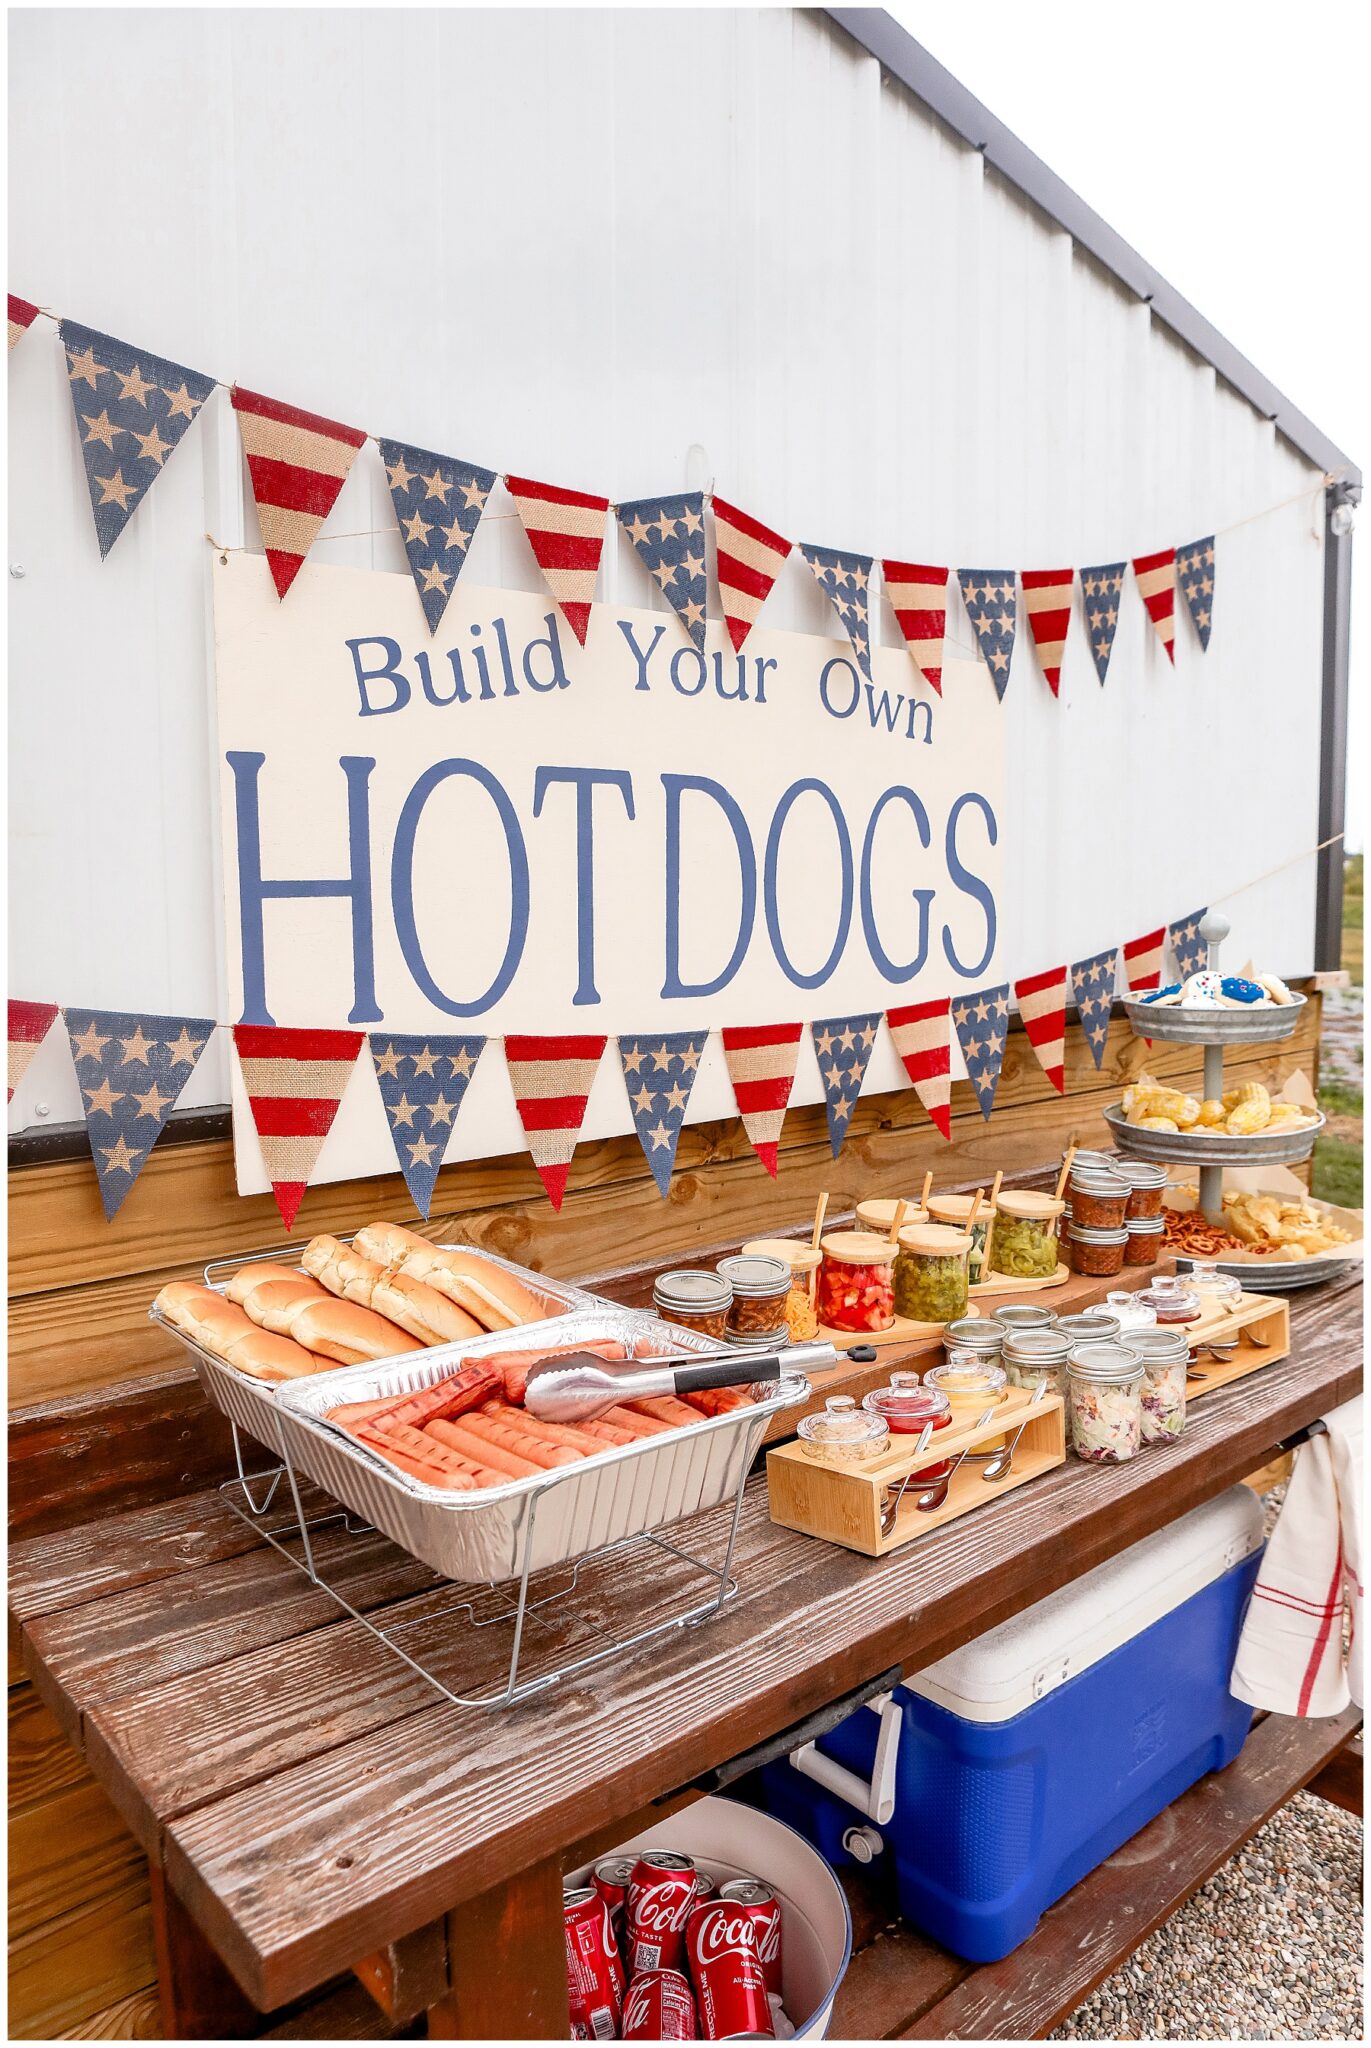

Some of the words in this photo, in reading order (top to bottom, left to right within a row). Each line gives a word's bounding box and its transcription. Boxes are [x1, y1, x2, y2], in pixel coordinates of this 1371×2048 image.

[345, 612, 571, 717] Build
[617, 620, 778, 704] Your
[819, 657, 934, 745] Own
[640, 1931, 664, 1942] TASTE
[700, 1970, 708, 1989] ME
[703, 1989, 716, 2040] RECYCLE
